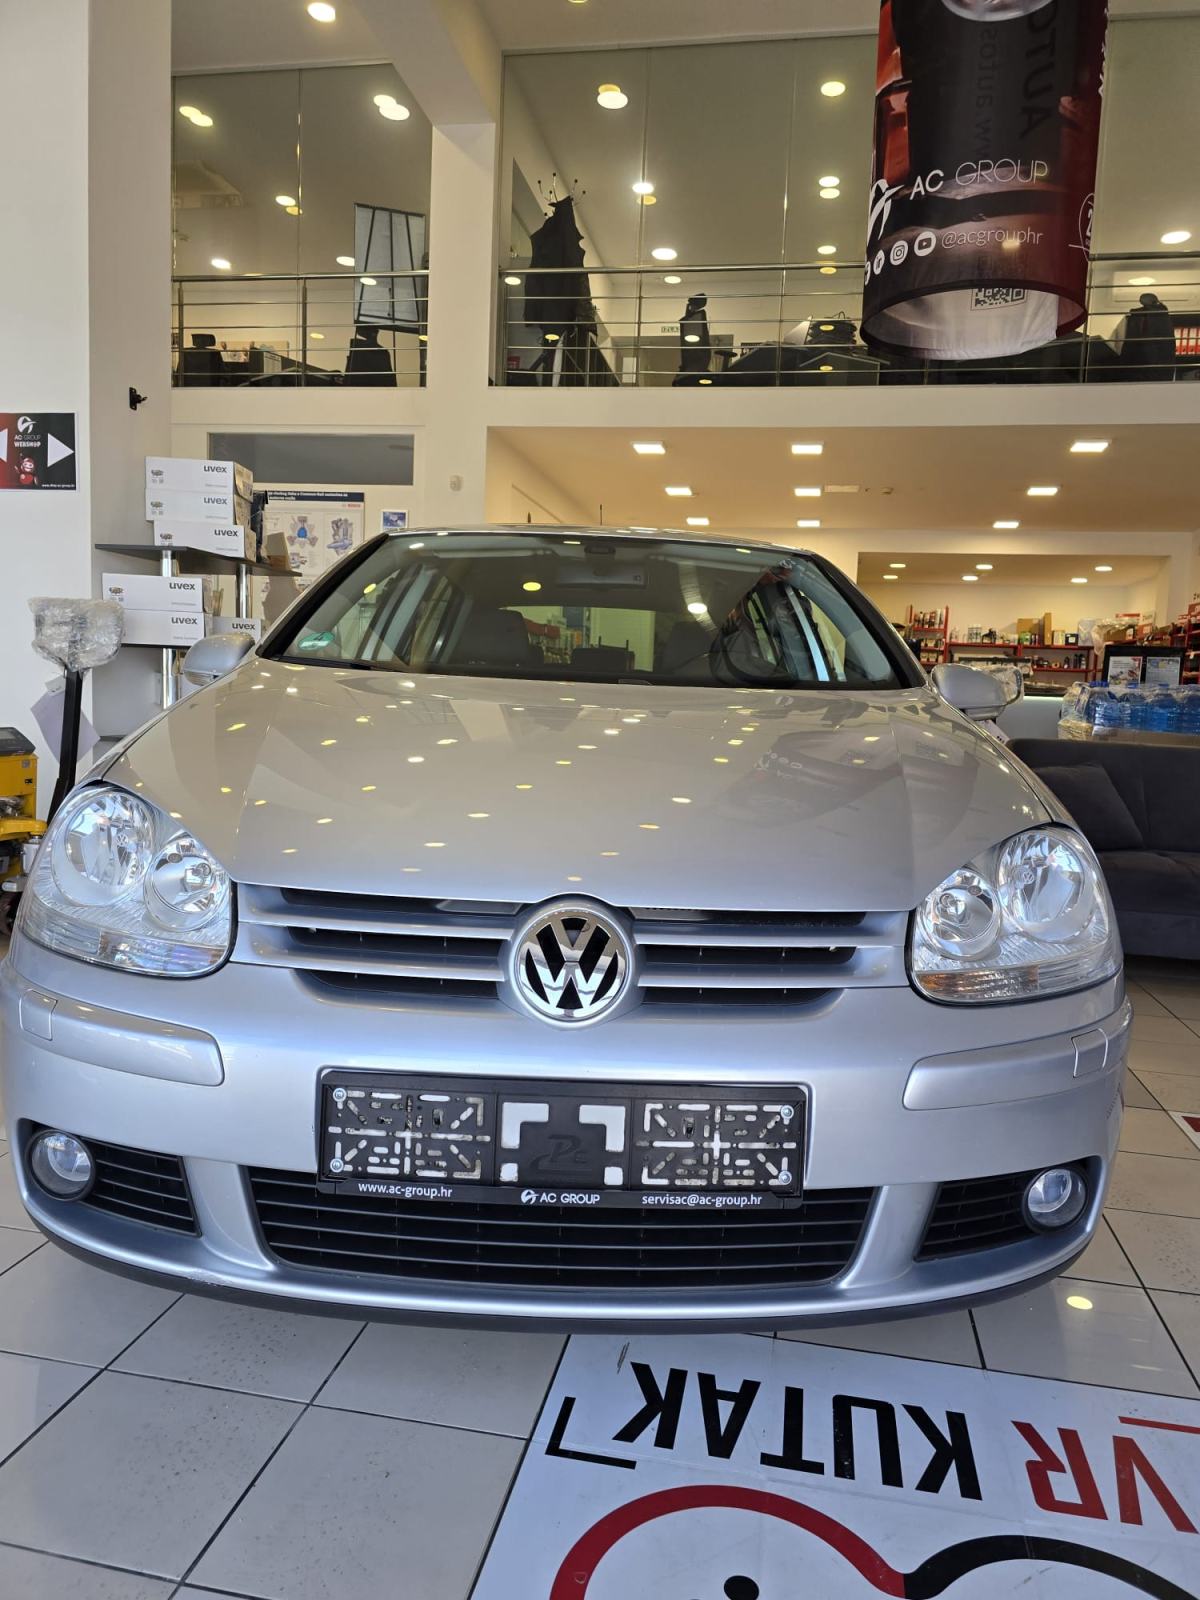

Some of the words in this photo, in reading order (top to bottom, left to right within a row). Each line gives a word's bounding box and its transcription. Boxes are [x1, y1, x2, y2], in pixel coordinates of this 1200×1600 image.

[909, 169, 944, 200] AC
[955, 158, 1048, 186] GROUP
[942, 226, 1044, 249] @acgrouphr
[203, 465, 228, 473] uvex
[203, 496, 228, 505] uvex
[214, 528, 238, 537] uvex
[169, 581, 196, 590] uvex
[171, 616, 198, 625] uvex
[232, 622, 256, 630] uvex
[358, 1180, 453, 1200] www.ac-group.hr
[539, 1193, 557, 1203] AC
[560, 1193, 601, 1205] GROUP
[641, 1192, 762, 1208] servisac@ac-group.hr
[612, 1361, 983, 1501] KUTAK
[1010, 1420, 1199, 1534] VR
